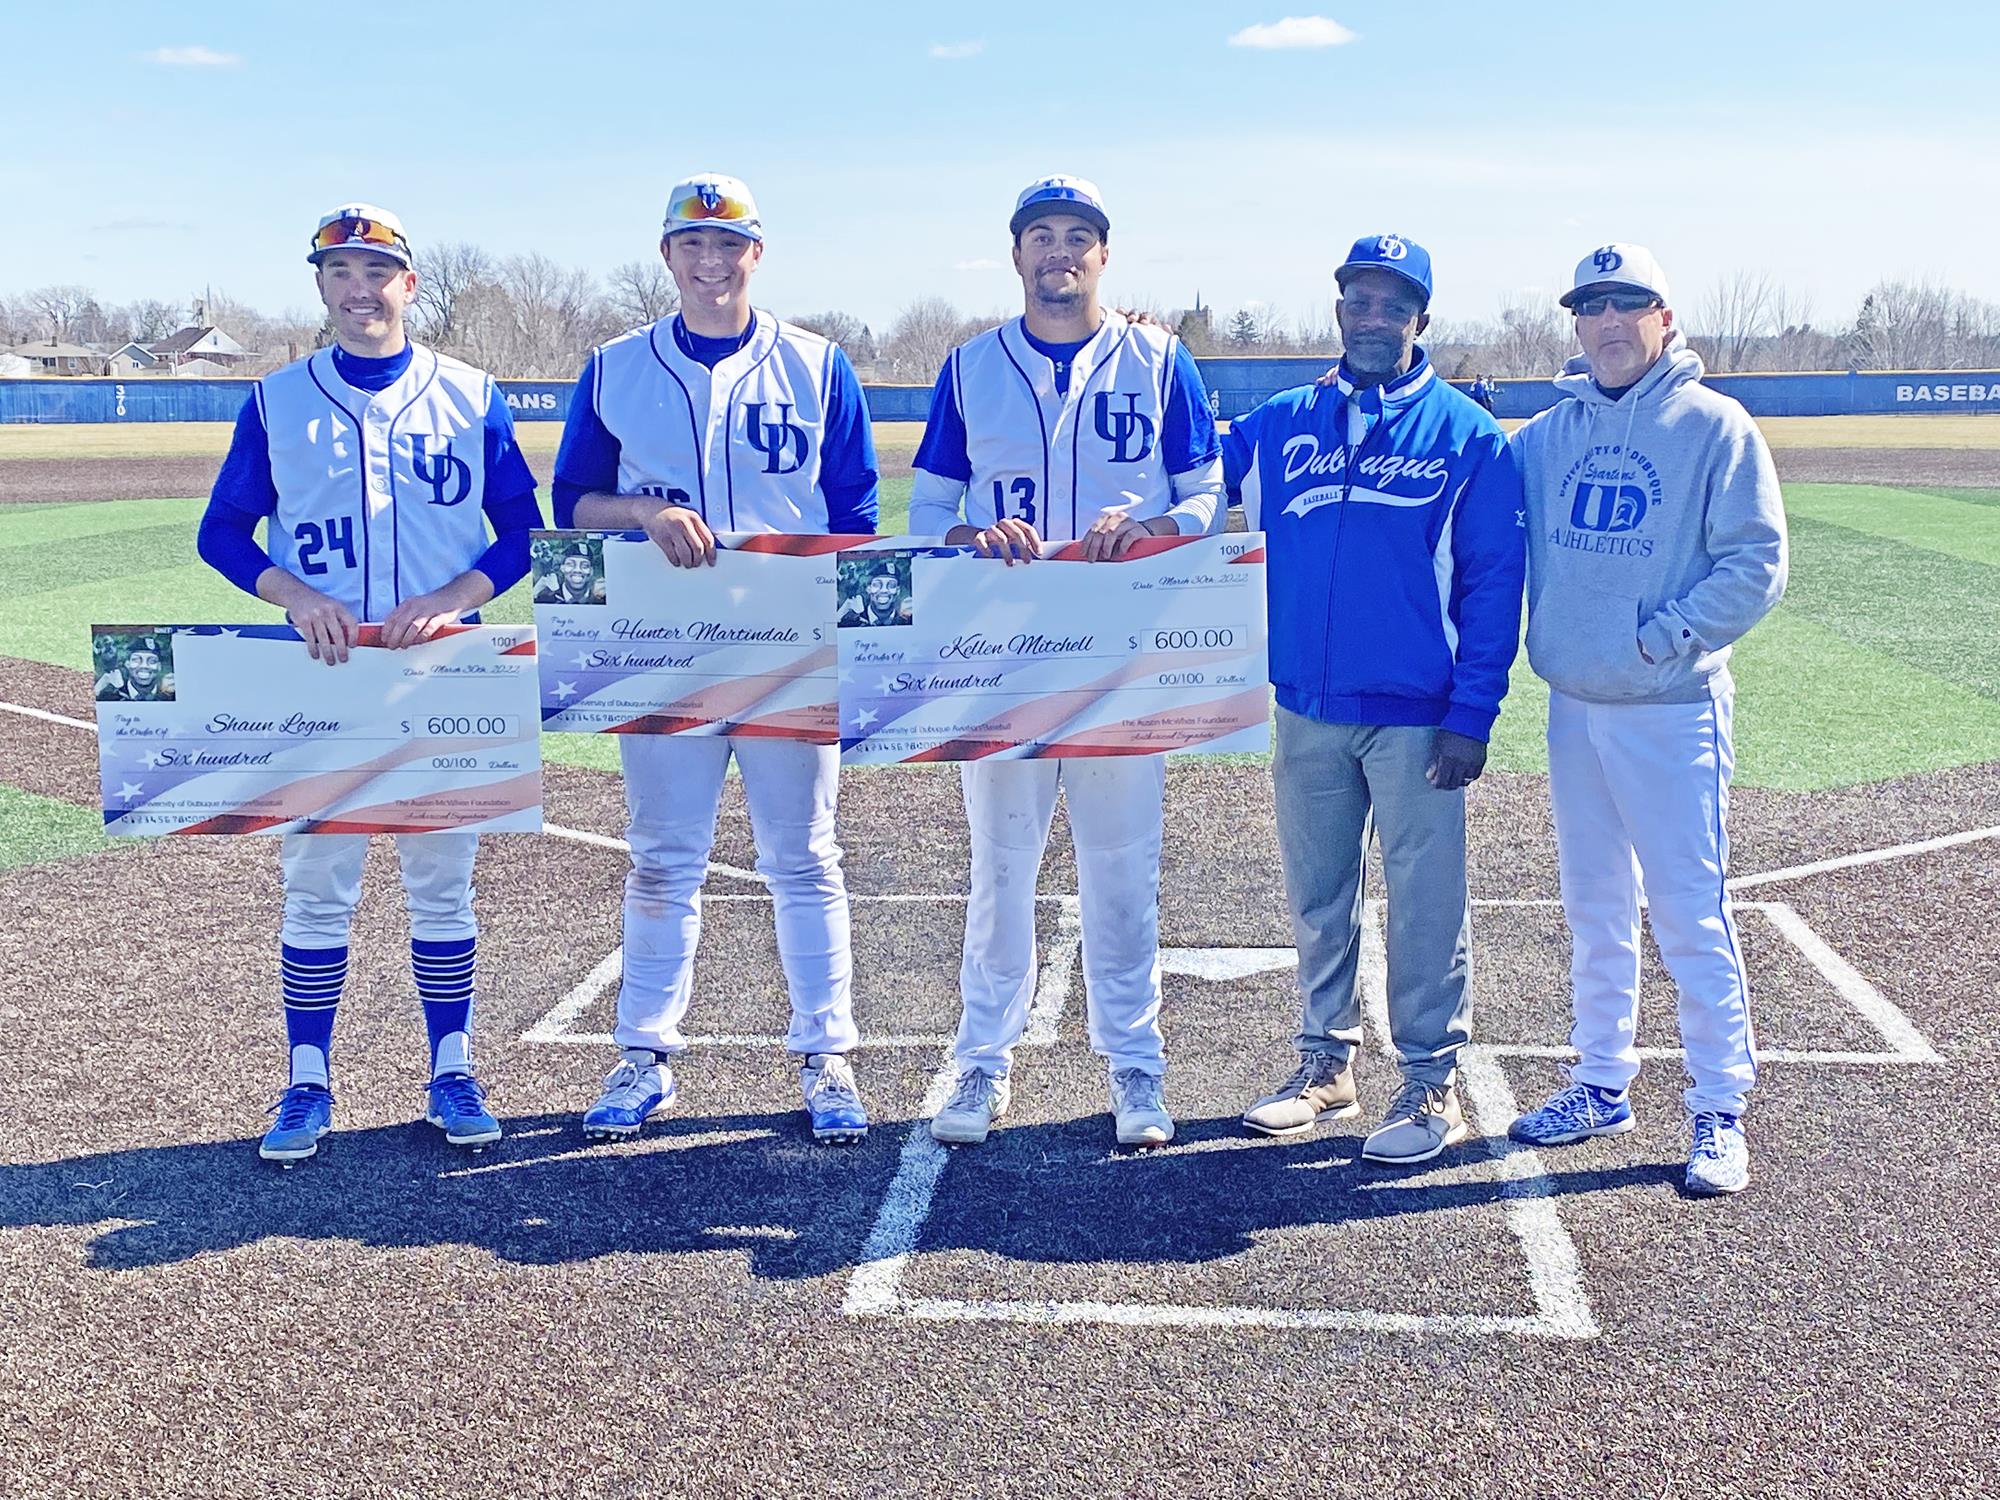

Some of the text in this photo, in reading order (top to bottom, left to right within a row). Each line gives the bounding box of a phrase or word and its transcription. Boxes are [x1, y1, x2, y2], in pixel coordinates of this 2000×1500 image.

[1378, 233, 1408, 260] UD
[1594, 245, 1623, 273] UD
[115, 384, 126, 417] 370
[743, 402, 808, 474] UD
[1094, 391, 1152, 463] UD
[403, 433, 471, 506] UD
[1282, 434, 1448, 491] Dubuque
[1630, 450, 1662, 506] DUBUQUE
[993, 477, 1036, 526] 13
[1303, 491, 1338, 506] BASEBALL
[294, 516, 357, 575] 24
[1220, 545, 1246, 555] 1001
[1159, 575, 1189, 585] March
[491, 636, 517, 647] 1001
[611, 618, 822, 643] Hunter Martindale $
[939, 628, 1234, 660] Kellen Mitchell $ 600.00
[430, 664, 460, 674] March
[586, 649, 695, 669] Six hundred
[889, 672, 927, 693] Six
[928, 673, 1004, 690] hundred
[1158, 672, 1205, 685] 00/100
[205, 712, 506, 737] Shaun Logan $ 600.00
[154, 748, 193, 768] Six
[194, 752, 272, 766] hundred
[432, 757, 477, 769] 00/100
